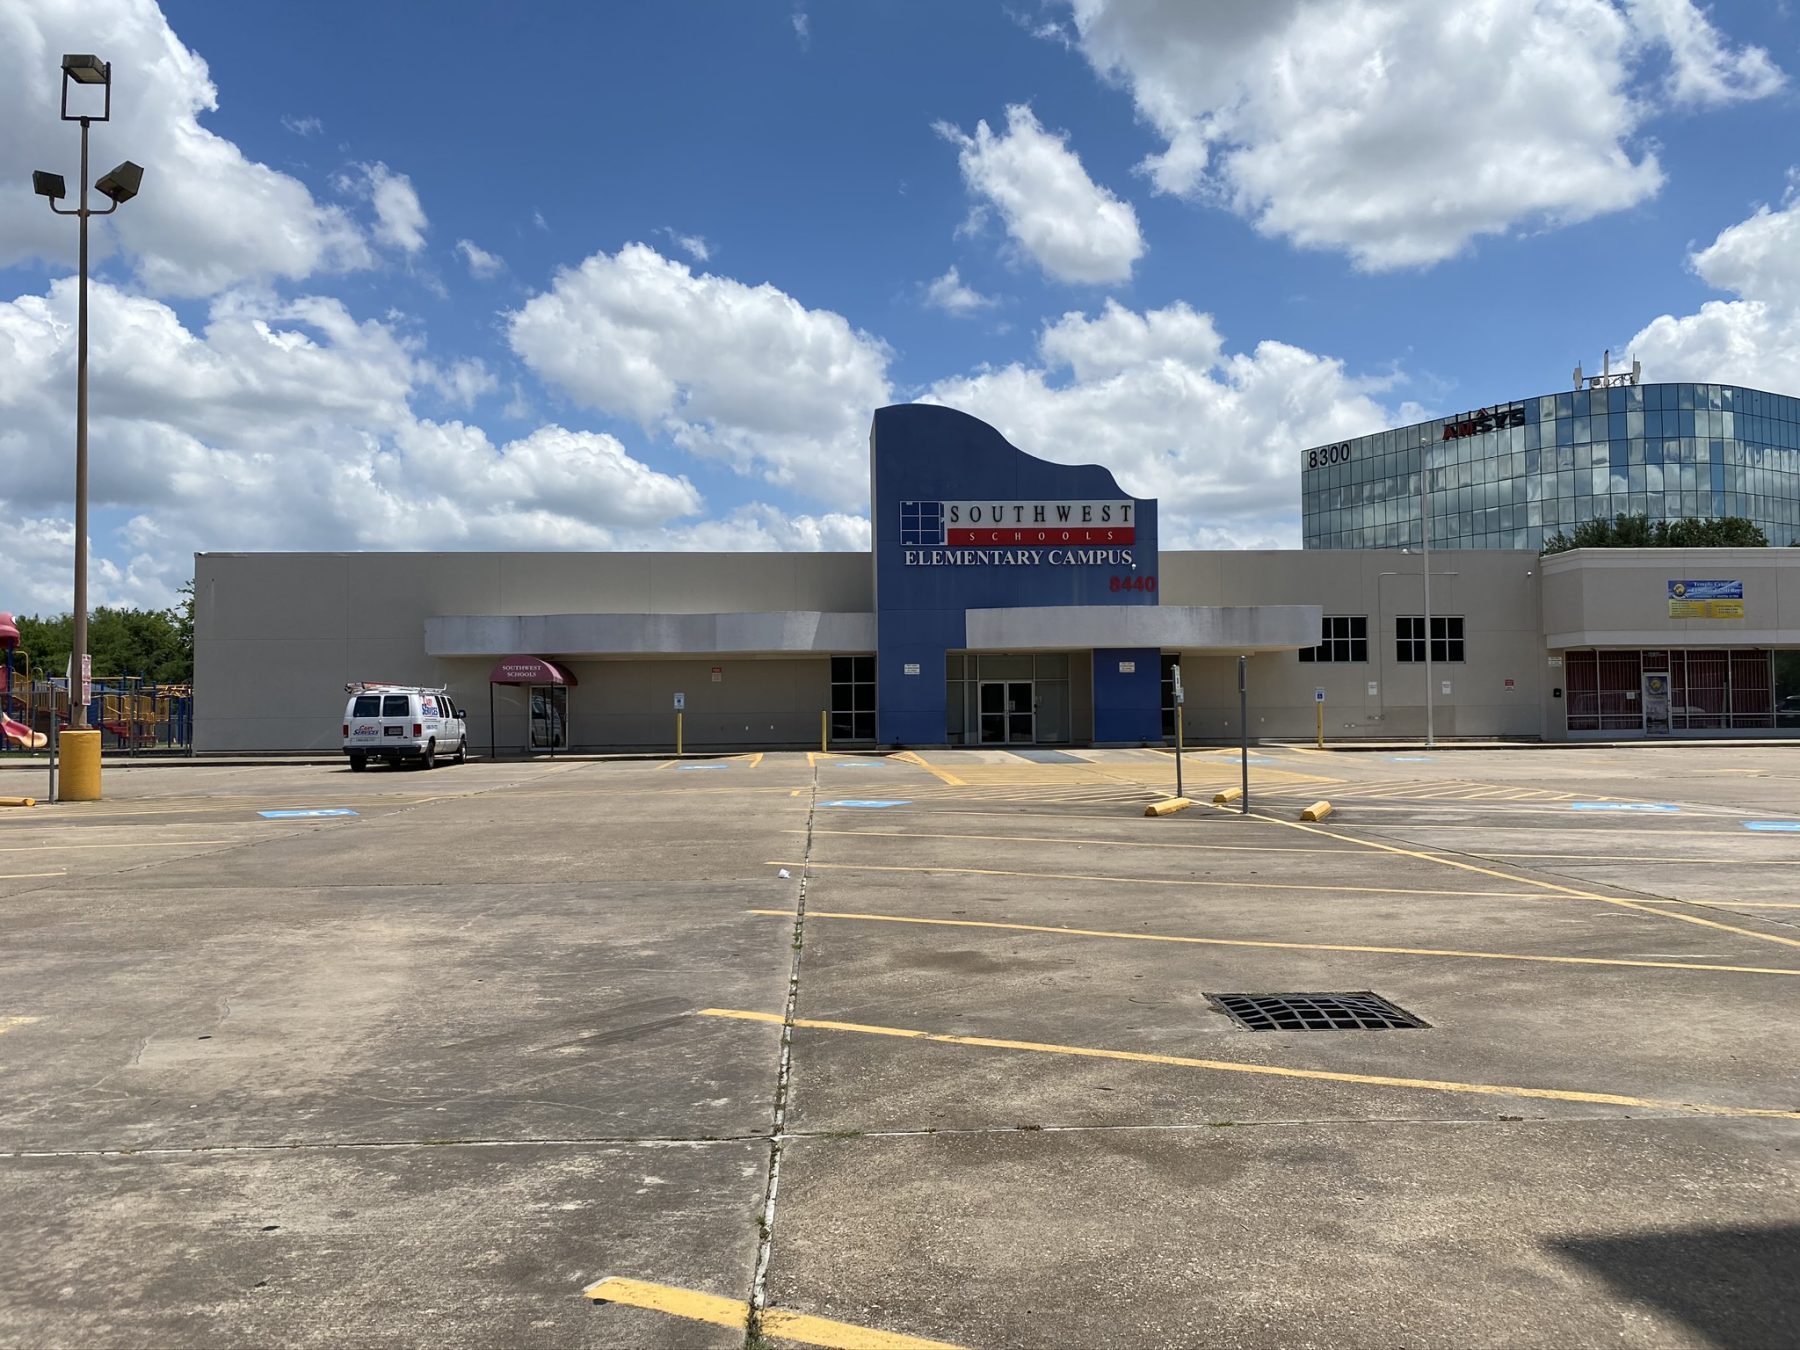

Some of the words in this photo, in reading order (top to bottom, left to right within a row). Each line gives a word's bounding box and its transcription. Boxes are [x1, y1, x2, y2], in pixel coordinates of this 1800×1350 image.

[1309, 443, 1350, 468] 8300
[950, 505, 1131, 523] SOUTHWEST
[969, 531, 1113, 541] SCHOOLS
[904, 550, 1043, 566] ELEMENTARY
[1048, 550, 1132, 565] CAMPUS
[1109, 575, 1156, 593] 8440
